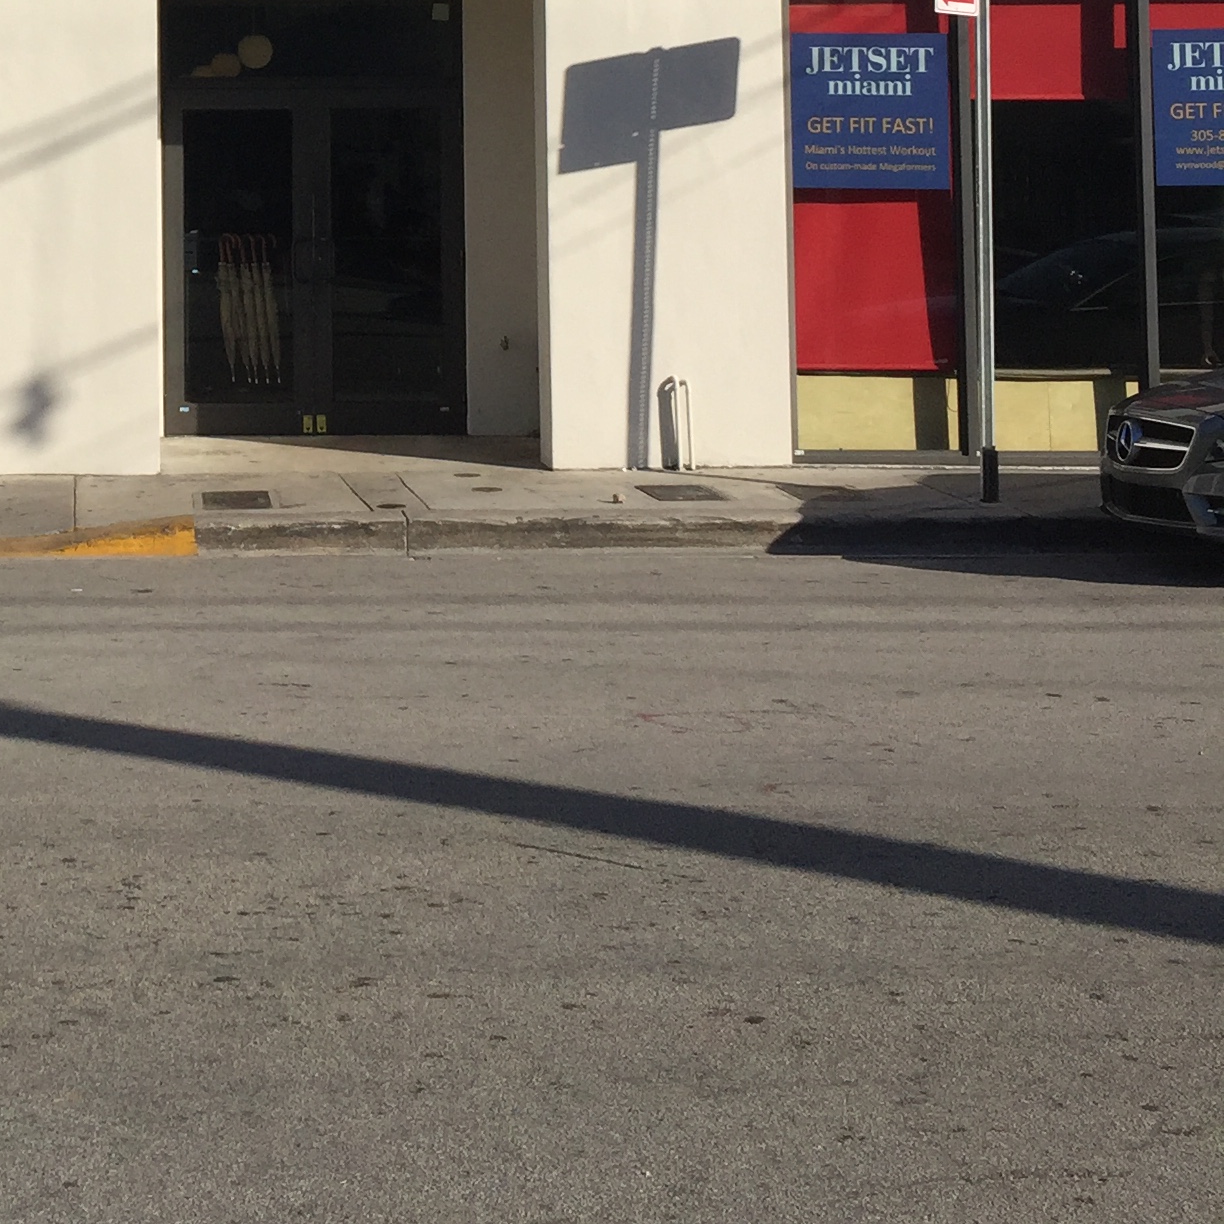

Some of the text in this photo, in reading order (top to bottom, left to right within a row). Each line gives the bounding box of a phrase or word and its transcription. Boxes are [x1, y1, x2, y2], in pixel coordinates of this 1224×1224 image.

[805, 46, 934, 75] JETSET
[1167, 41, 1224, 71] JET
[827, 73, 913, 96] miami
[1190, 68, 1224, 91] mi
[1170, 102, 1207, 120] GET
[807, 116, 934, 135] GET FIT FAST!
[804, 144, 936, 157] Miami's Hottest Workout
[805, 161, 818, 171] On
[819, 161, 877, 171] custom-made
